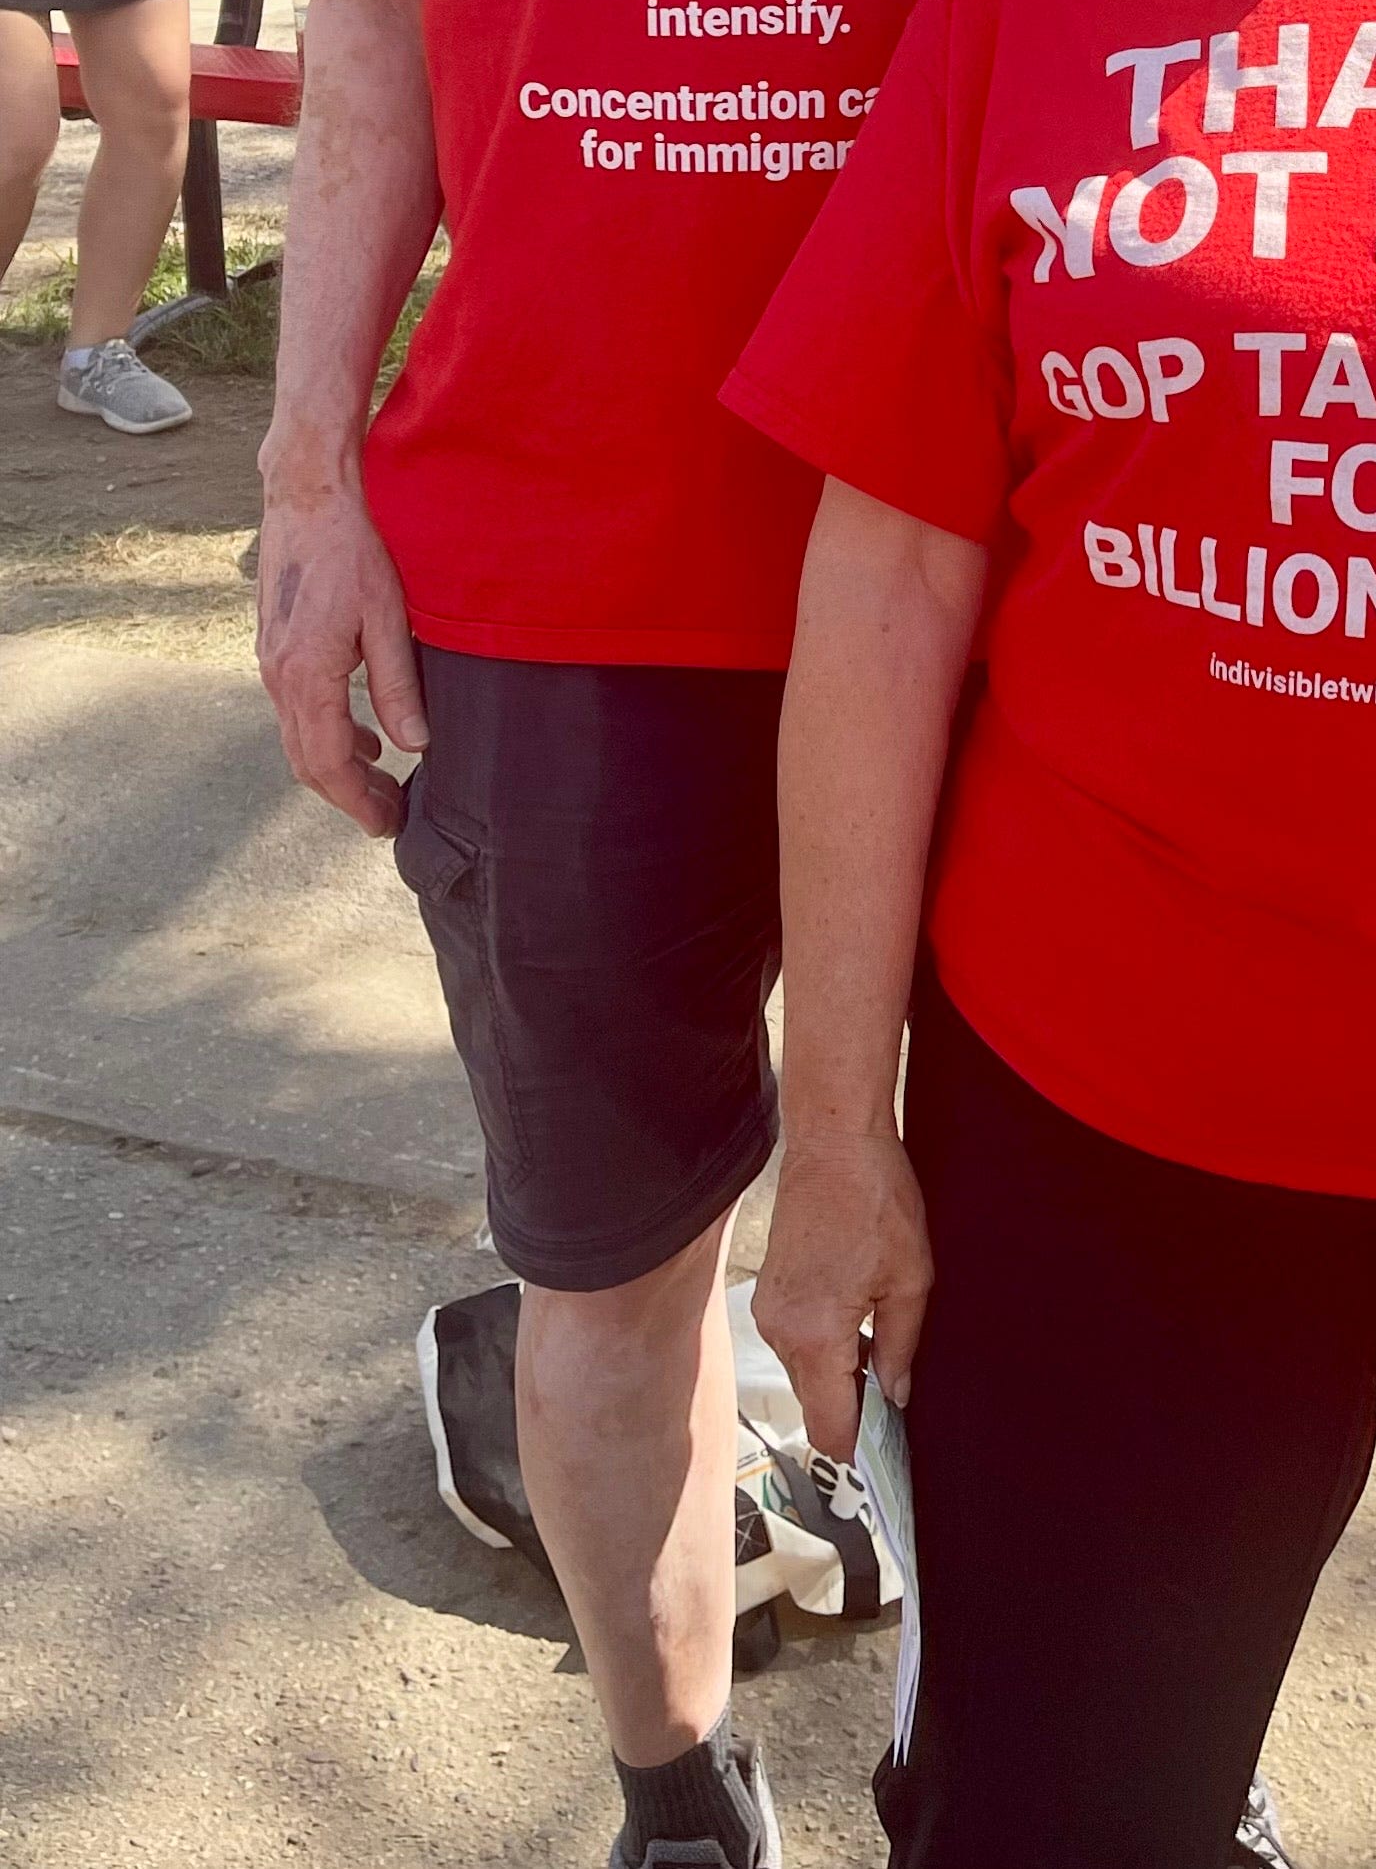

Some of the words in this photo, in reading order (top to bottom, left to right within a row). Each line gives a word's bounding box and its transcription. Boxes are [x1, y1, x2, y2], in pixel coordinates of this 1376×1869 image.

[519, 81, 825, 122] Concentration
[580, 129, 642, 170] for
[1009, 151, 1328, 284] NOT
[1041, 336, 1204, 422] GOP
